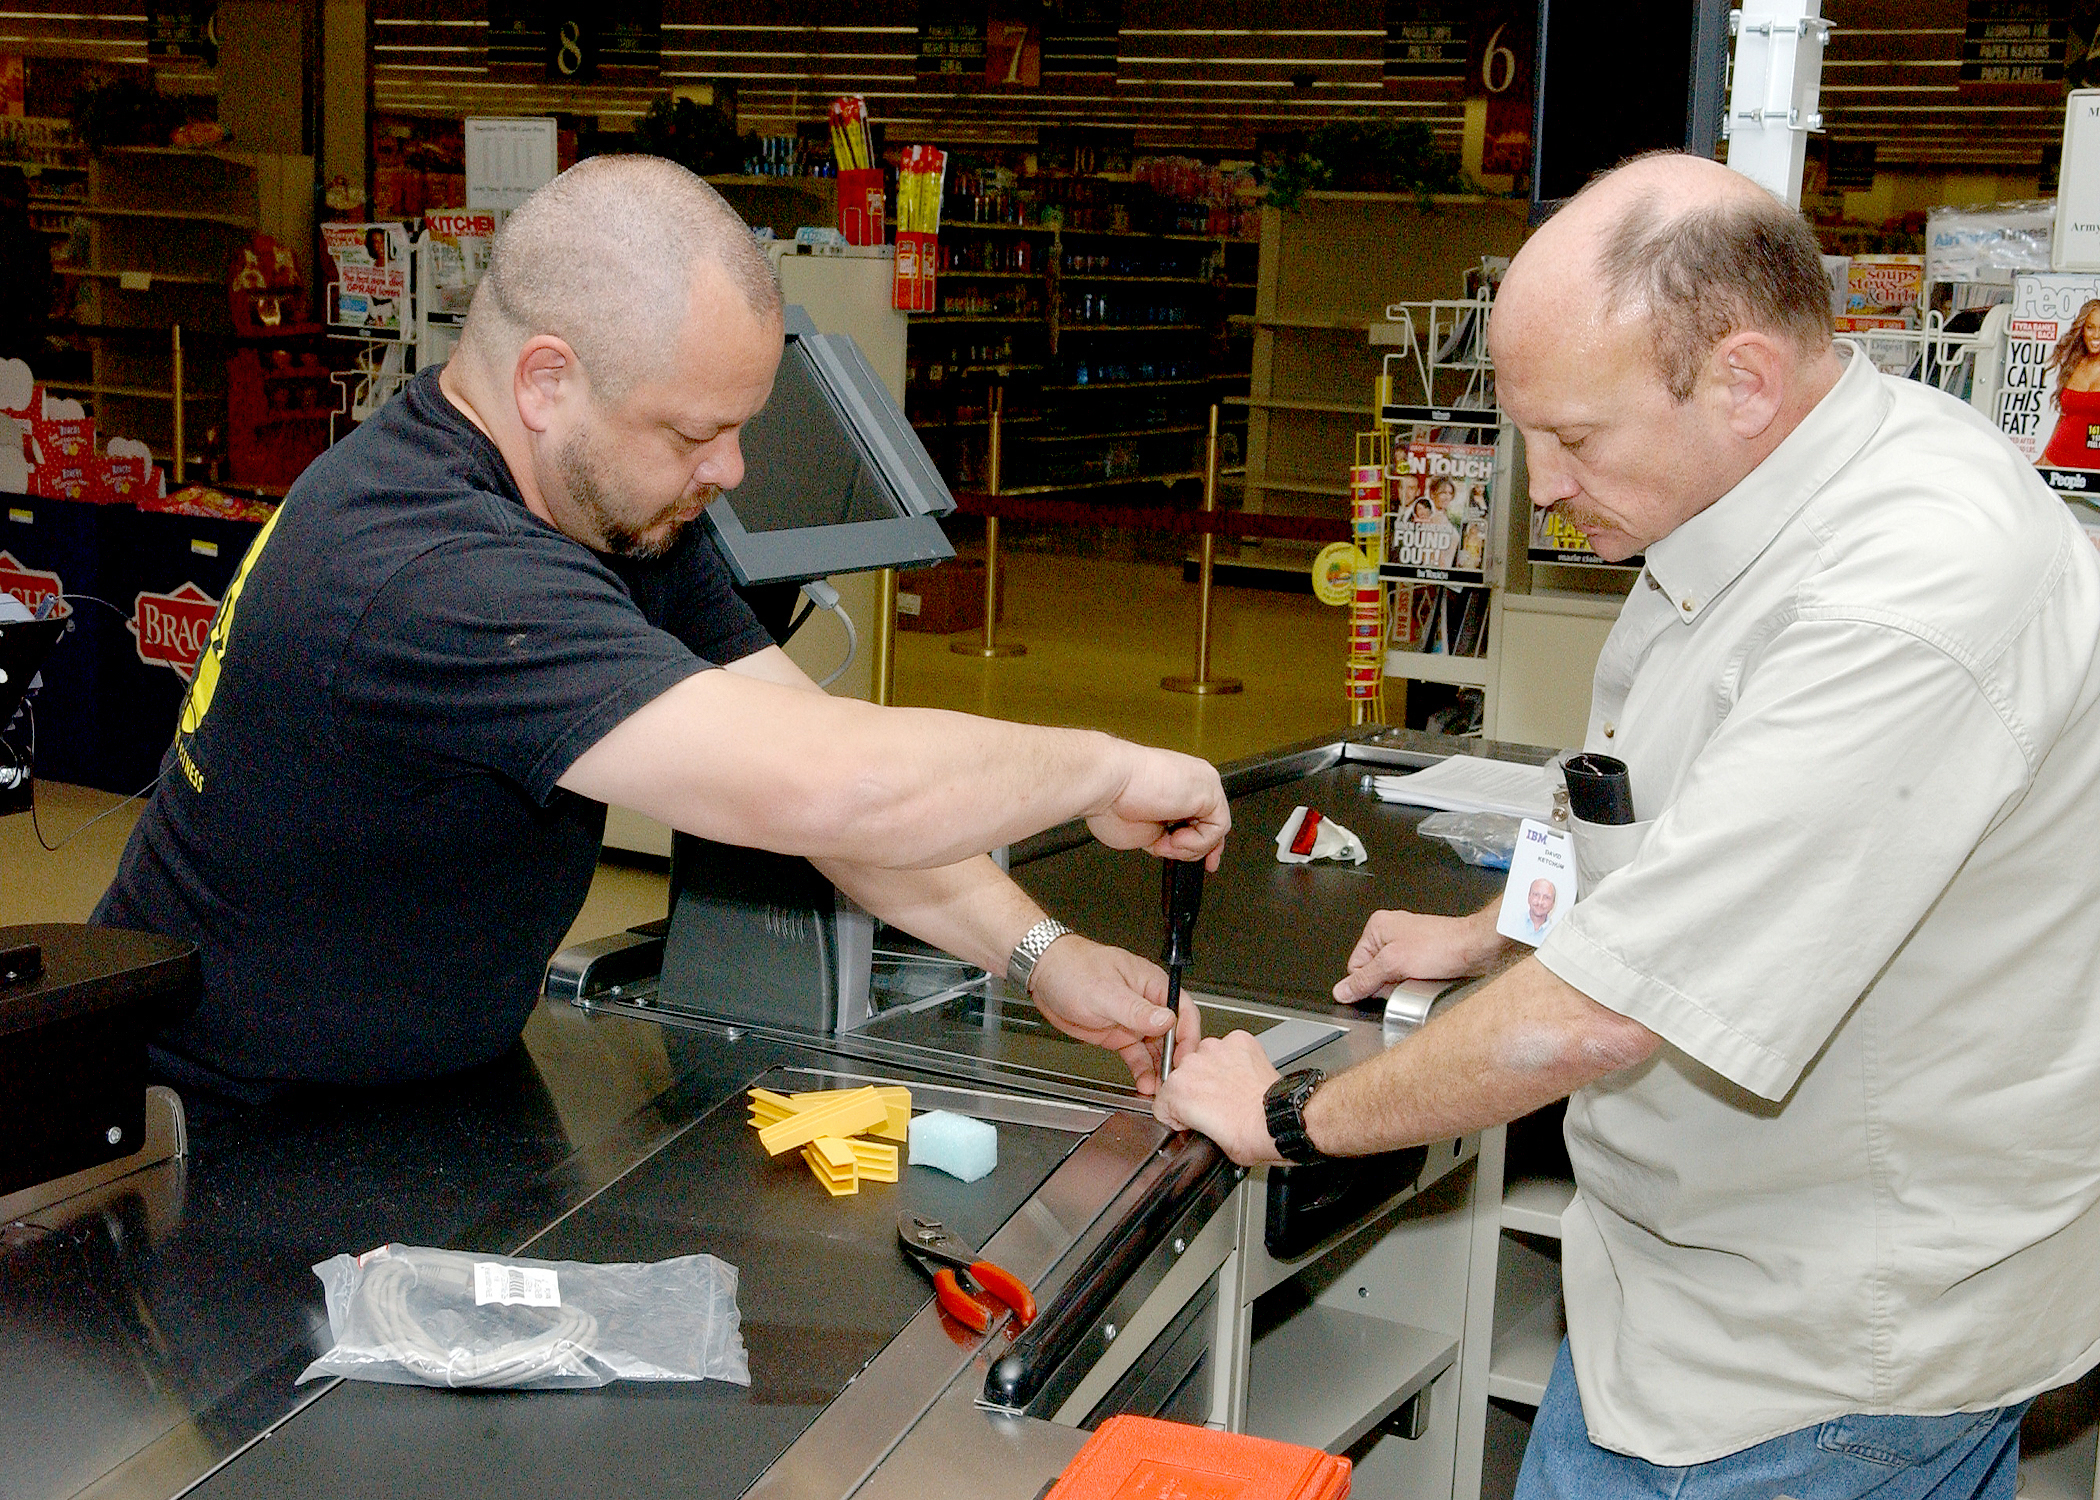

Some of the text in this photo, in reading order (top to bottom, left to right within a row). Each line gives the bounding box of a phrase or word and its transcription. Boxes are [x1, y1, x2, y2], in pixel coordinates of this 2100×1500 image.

[557, 20, 582, 75] 8
[1002, 25, 1028, 83] 7
[1481, 22, 1515, 93] 6
[1849, 277, 1898, 290] stews
[1868, 270, 1918, 284] soups
[2014, 322, 2057, 333] TYRA BANKS
[2011, 342, 2046, 365] YOU
[2007, 366, 2047, 389] CALL
[2004, 390, 2042, 412] THIS
[2002, 413, 2040, 436] FAT?
[1427, 453, 1492, 479] TOUCH
[2050, 471, 2087, 490] People
[1545, 513, 1588, 537] JEA
[1394, 530, 1450, 550] FOUND
[1400, 547, 1441, 567] OUT!
[1525, 828, 1549, 846] IBM
[1544, 849, 1562, 860] DAVID
